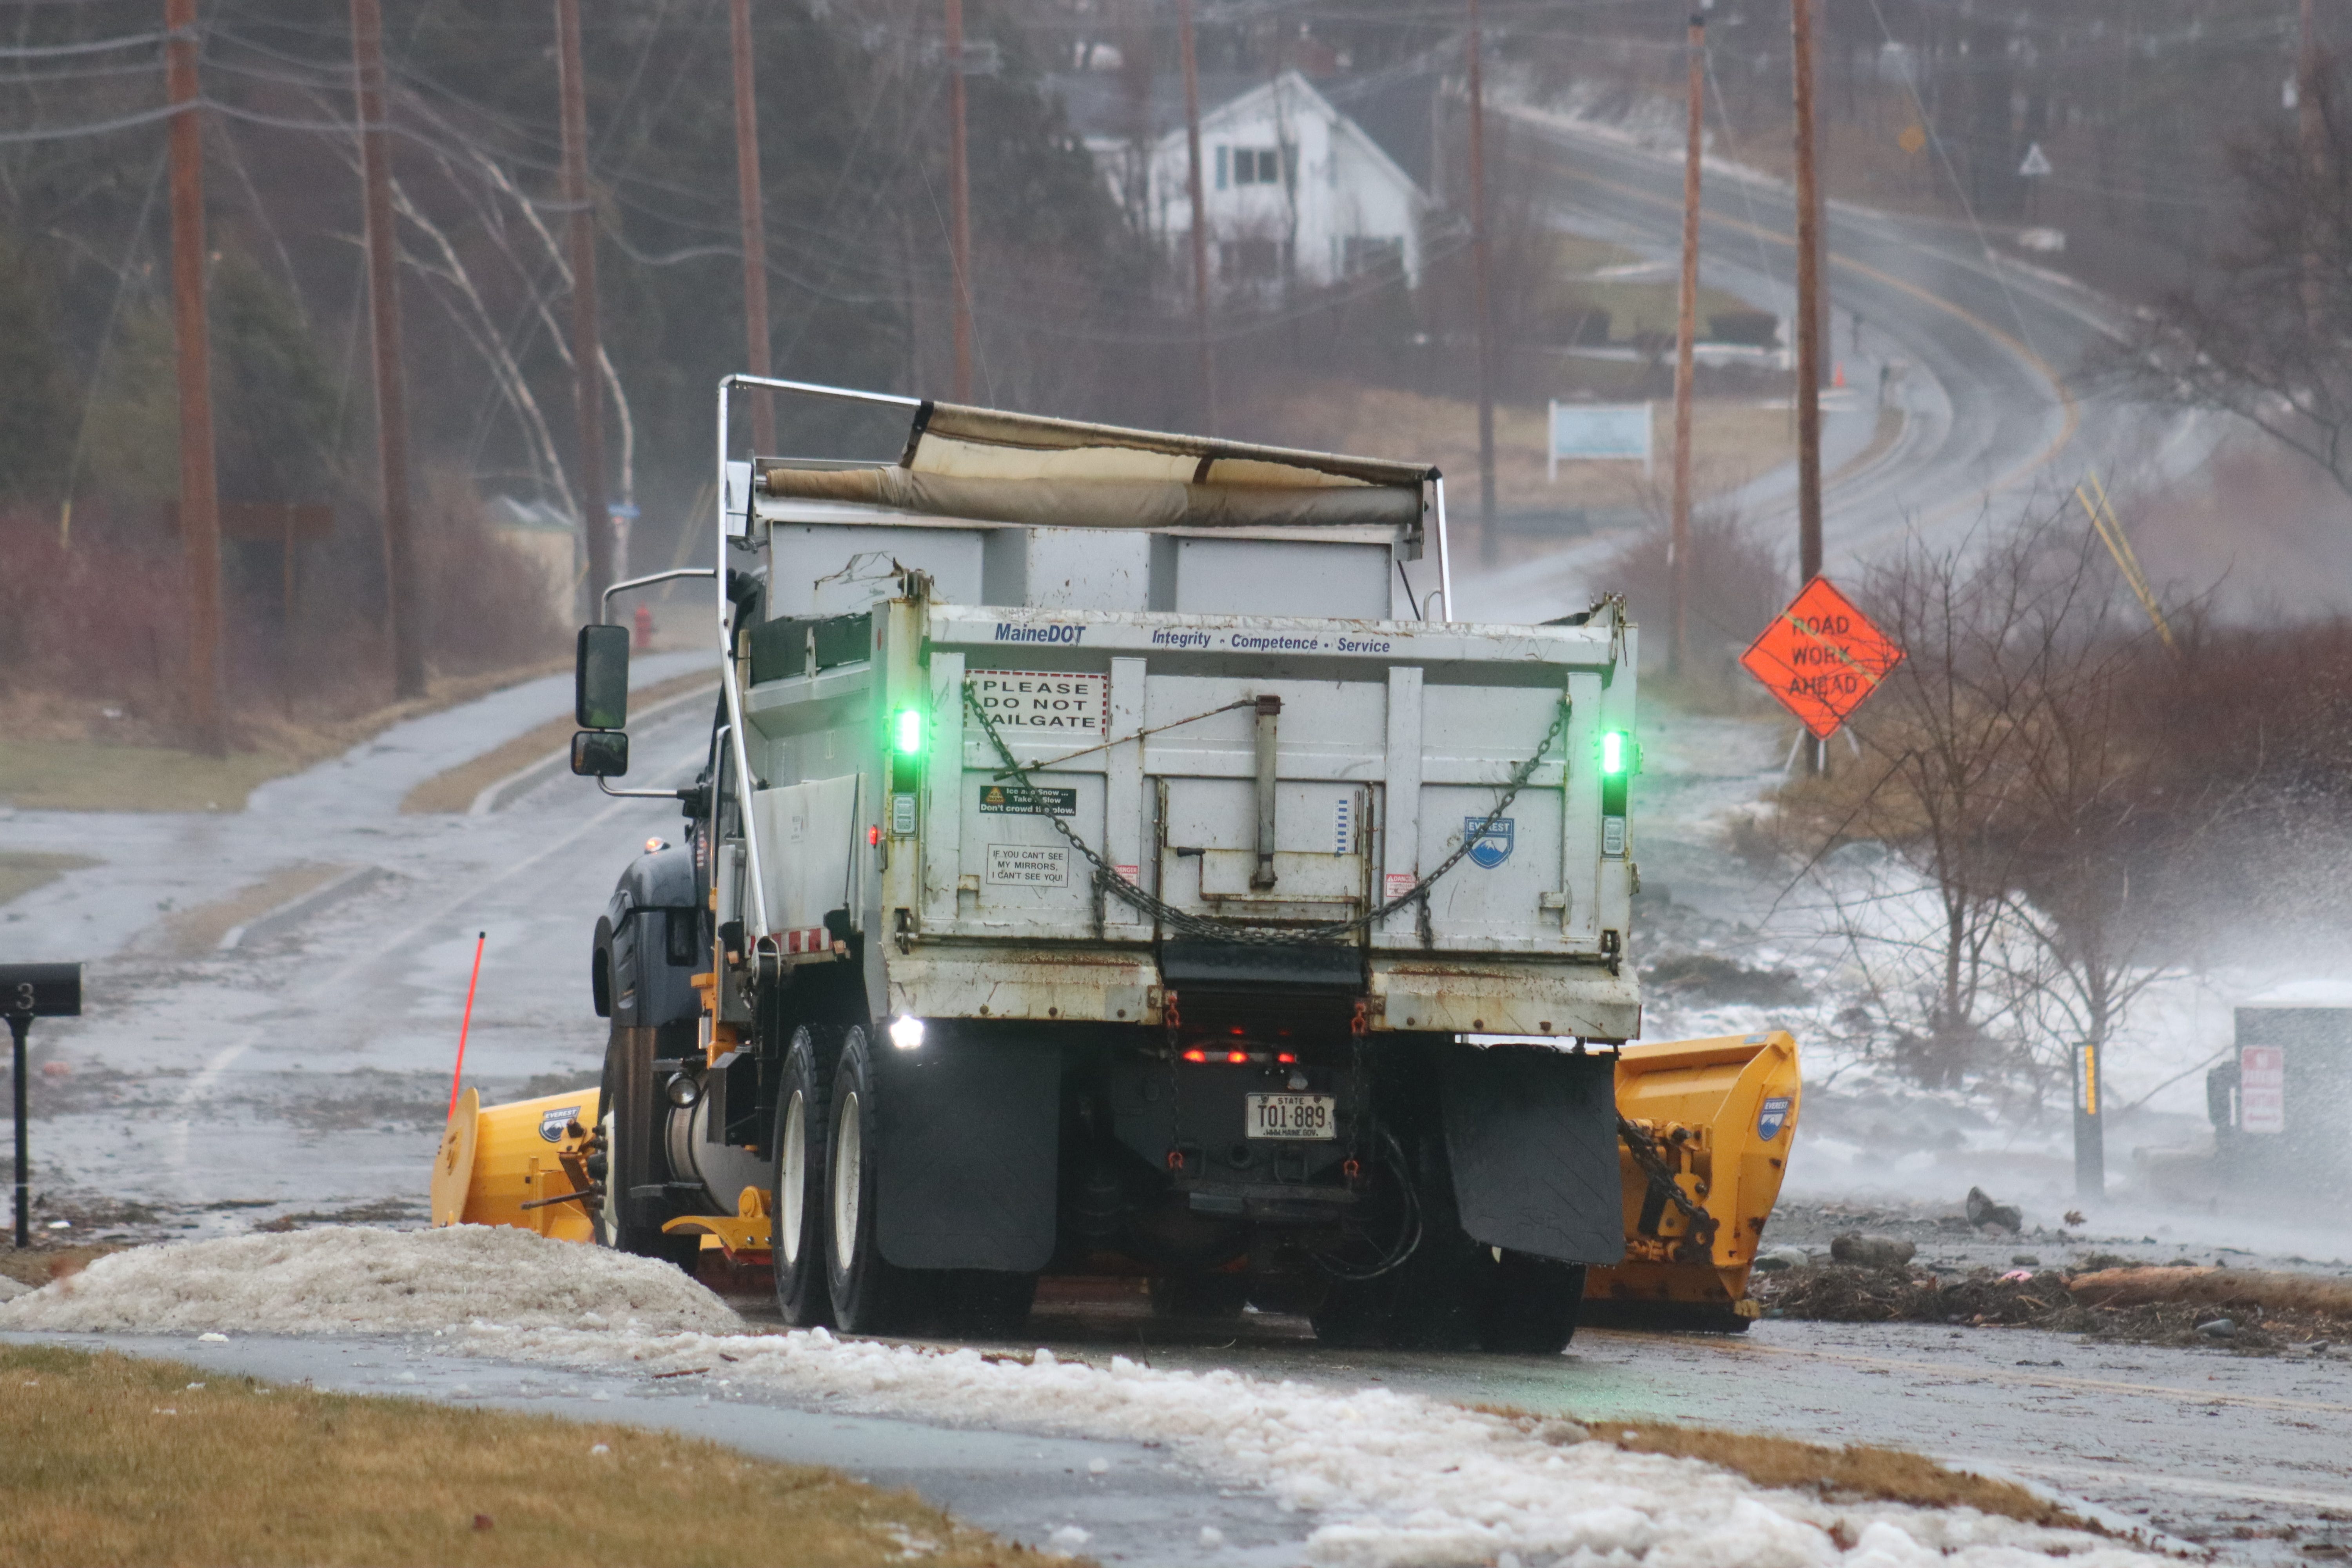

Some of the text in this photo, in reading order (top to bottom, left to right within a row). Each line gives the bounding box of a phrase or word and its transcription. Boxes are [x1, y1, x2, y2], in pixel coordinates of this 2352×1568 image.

[995, 622, 1086, 644] MaineDOT
[1152, 630, 1390, 653] Integrity Competence Service
[984, 681, 1088, 695] PLEASE
[1789, 675, 1858, 695] AHEAD
[984, 697, 1087, 711] DO NOT
[984, 714, 1095, 728] AILGATE
[1014, 862, 1058, 871] MIRRORS,
[16, 983, 35, 1009] 3
[1764, 1101, 1789, 1110] EVEREST
[545, 1109, 578, 1119] EVEREST
